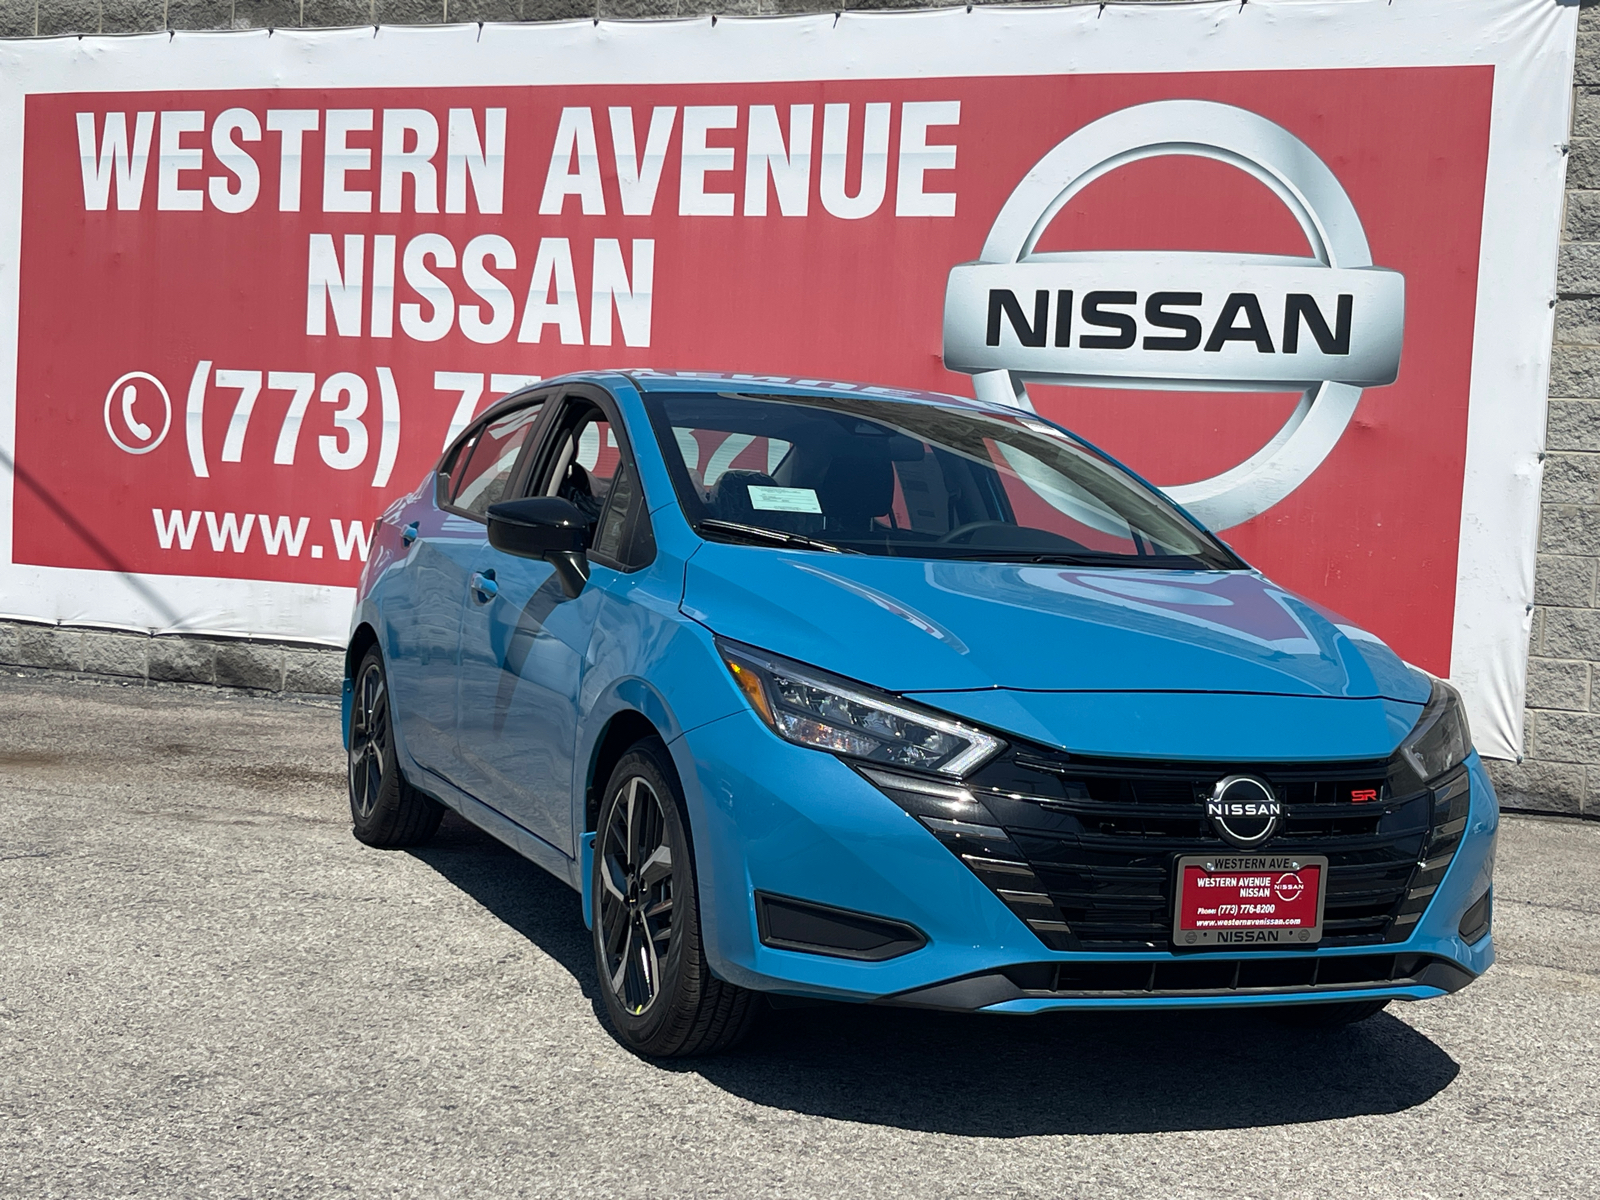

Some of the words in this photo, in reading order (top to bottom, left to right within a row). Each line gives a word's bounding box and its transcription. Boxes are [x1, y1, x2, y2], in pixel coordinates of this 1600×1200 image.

[75, 107, 507, 214] WESTERN
[538, 100, 961, 220] AVENUE
[306, 233, 655, 348] NISSAN
[986, 288, 1353, 356] NISSAN
[185, 360, 401, 487] (773)
[1351, 790, 1377, 802] SR
[1208, 803, 1280, 816] NISSAN
[1214, 858, 1266, 869] WESTERN
[1197, 877, 1237, 888] WESTERN
[1238, 877, 1271, 887] AVENUE
[1239, 887, 1270, 898] NISSAN
[1197, 907, 1216, 915] Phone:
[1218, 904, 1238, 916] (773)
[1240, 904, 1275, 914] 776-8200
[1196, 918, 1301, 927] www.westernavenissan.com
[1217, 930, 1279, 942] NISSAN
